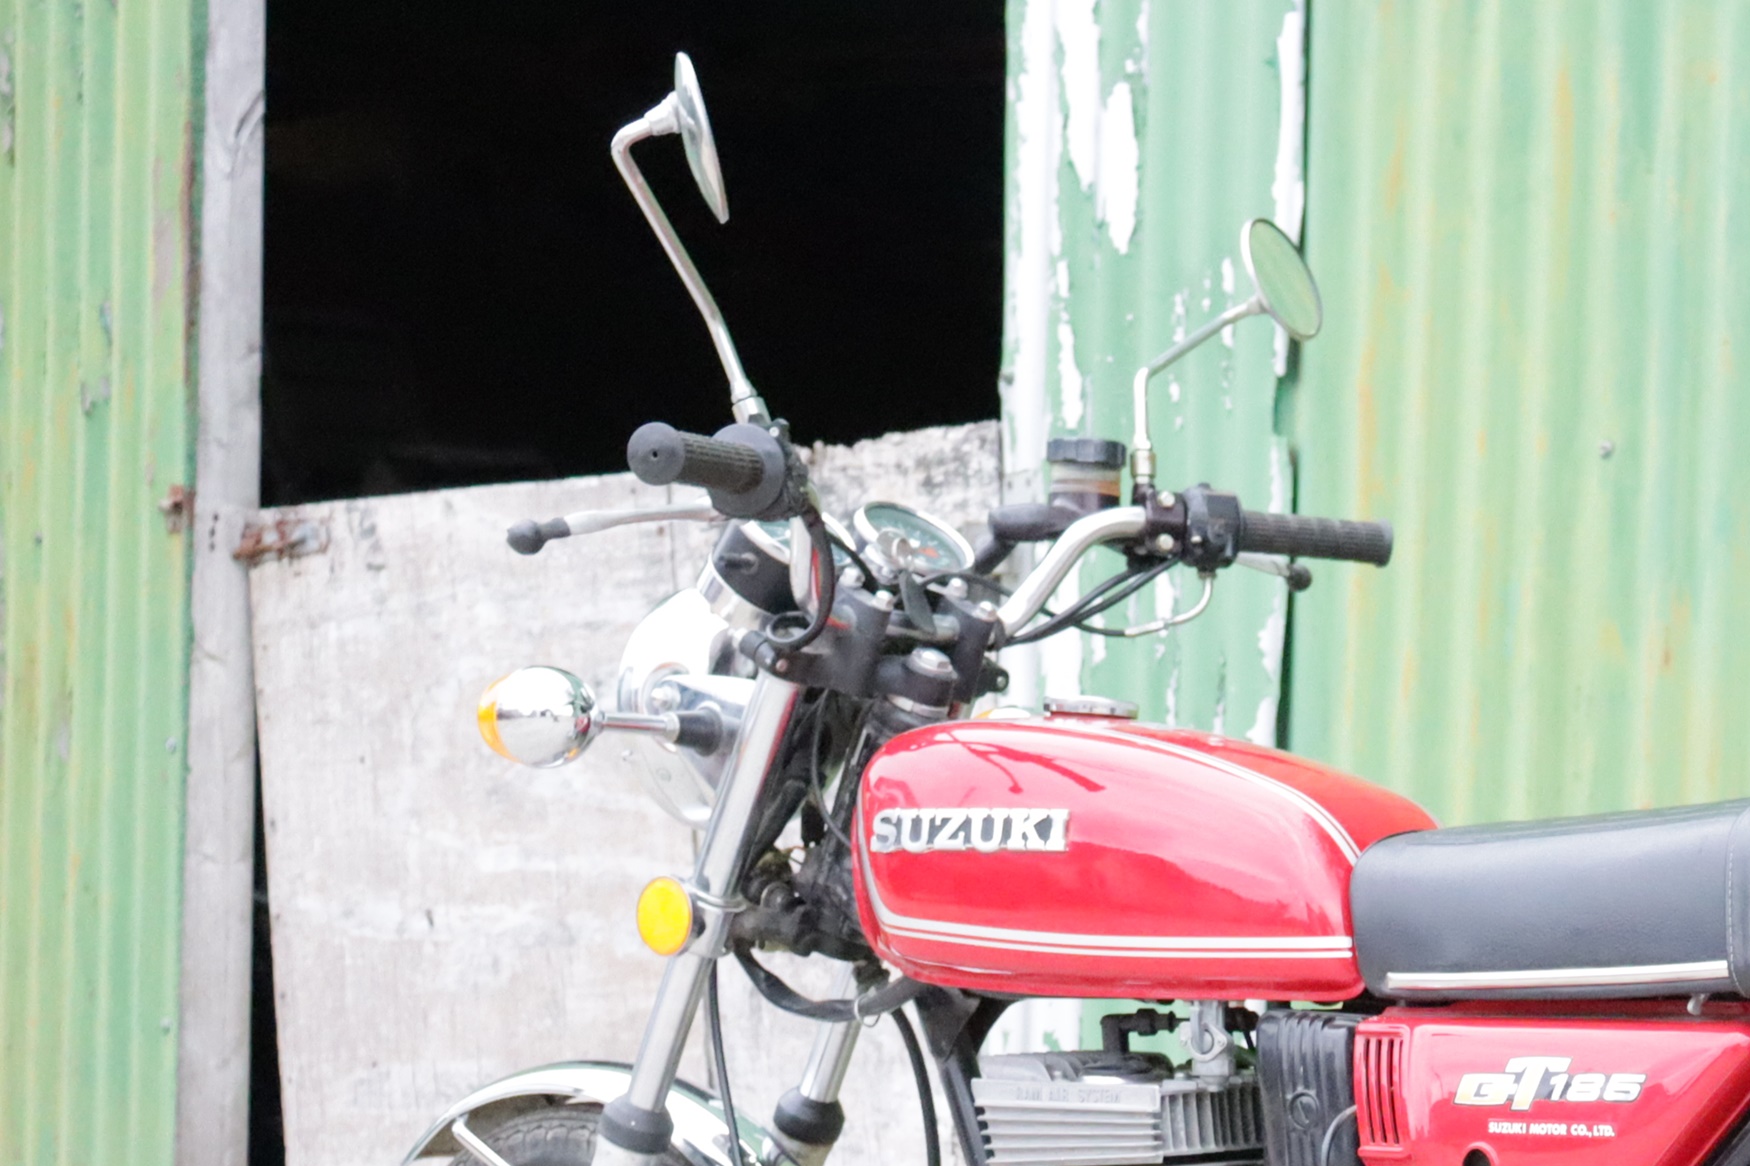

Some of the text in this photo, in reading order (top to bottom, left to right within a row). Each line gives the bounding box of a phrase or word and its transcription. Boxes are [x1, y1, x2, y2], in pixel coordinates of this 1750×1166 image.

[870, 807, 1069, 853] SUZUKI
[1488, 1121, 1527, 1134] SUZUKI
[1529, 1123, 1567, 1136] MOTOR
